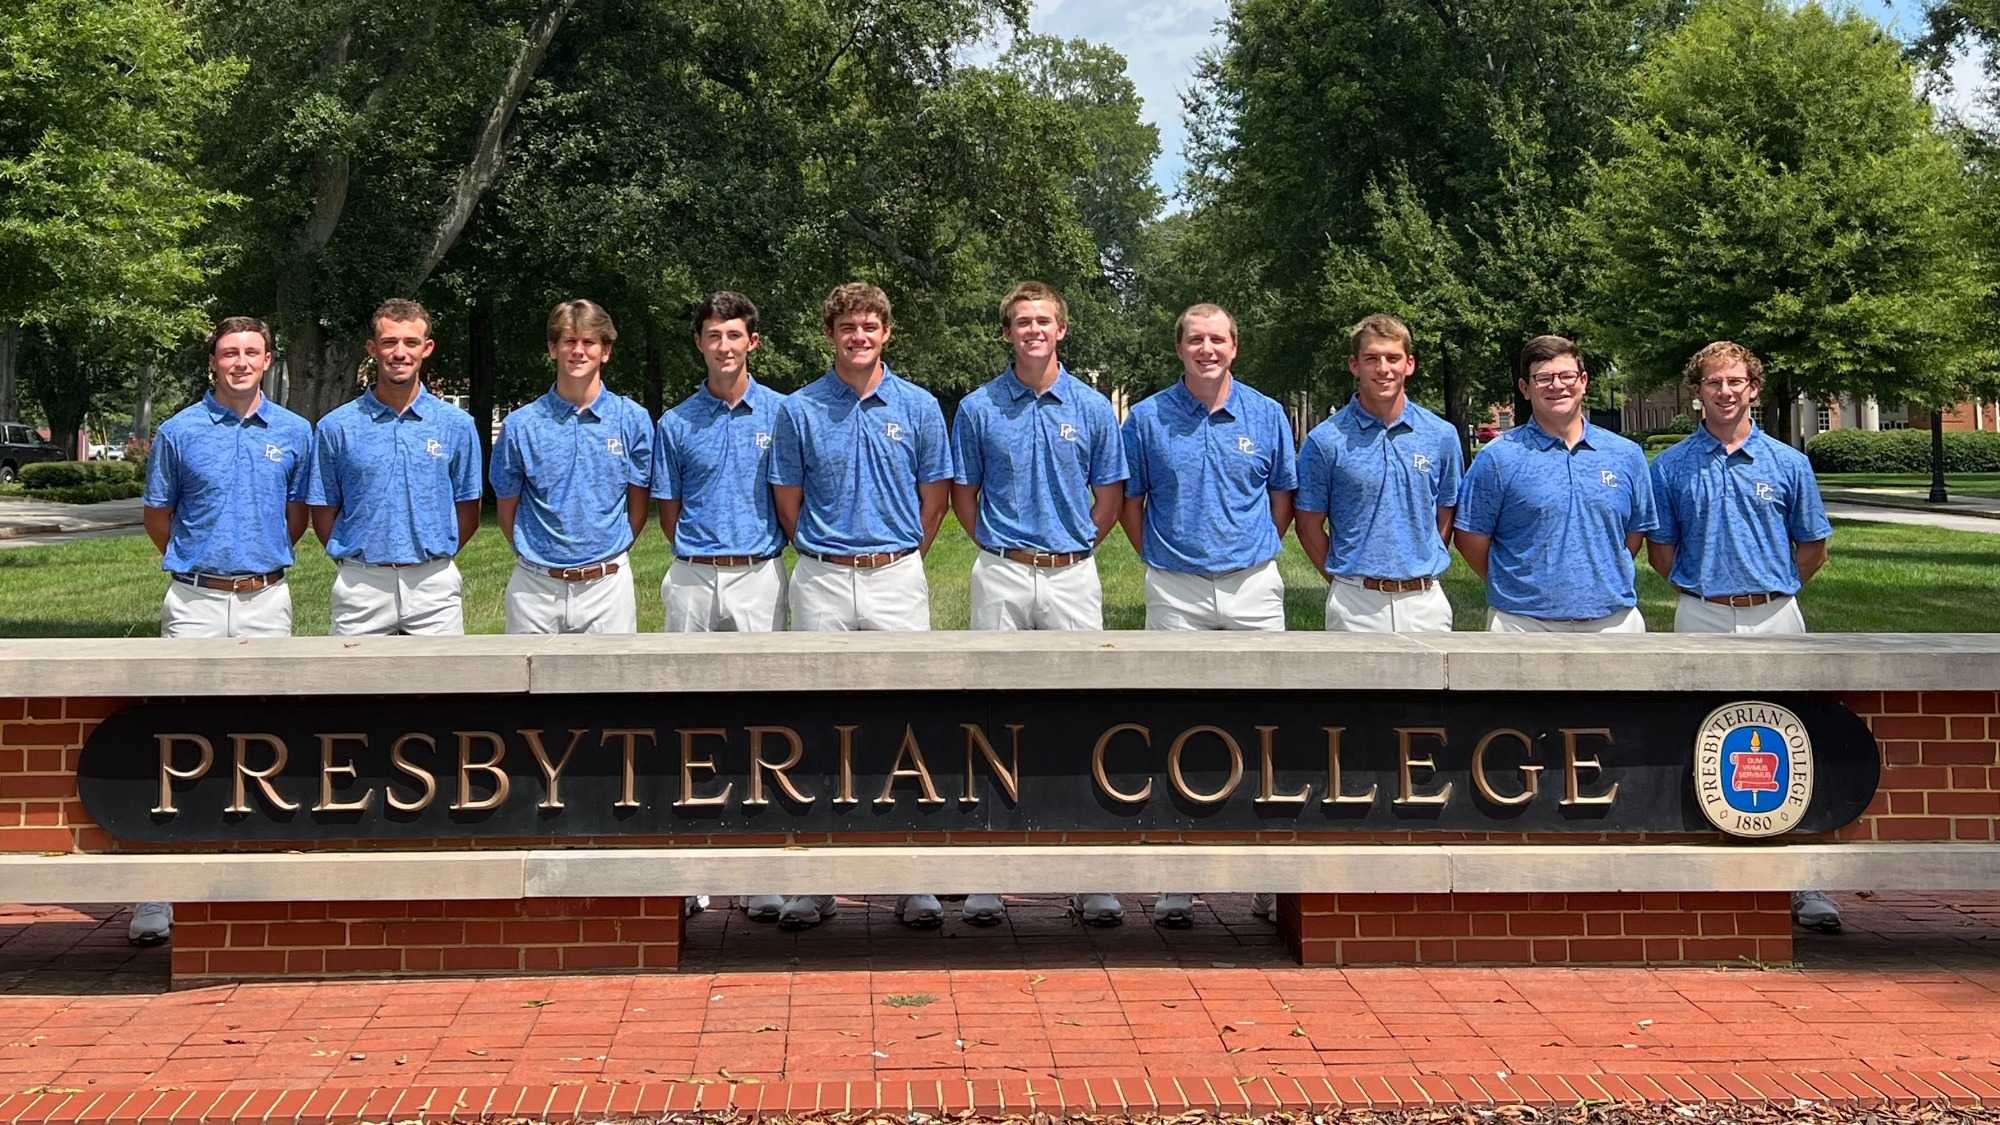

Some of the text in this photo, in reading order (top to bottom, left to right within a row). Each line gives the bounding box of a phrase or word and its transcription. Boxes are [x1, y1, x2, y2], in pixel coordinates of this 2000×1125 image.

[150, 722, 1619, 813] PRESBYTERIAN COLLEGE
[1702, 707, 1807, 807] PRESBYTERIAN COLLEGE
[1735, 815, 1772, 831] 1880
